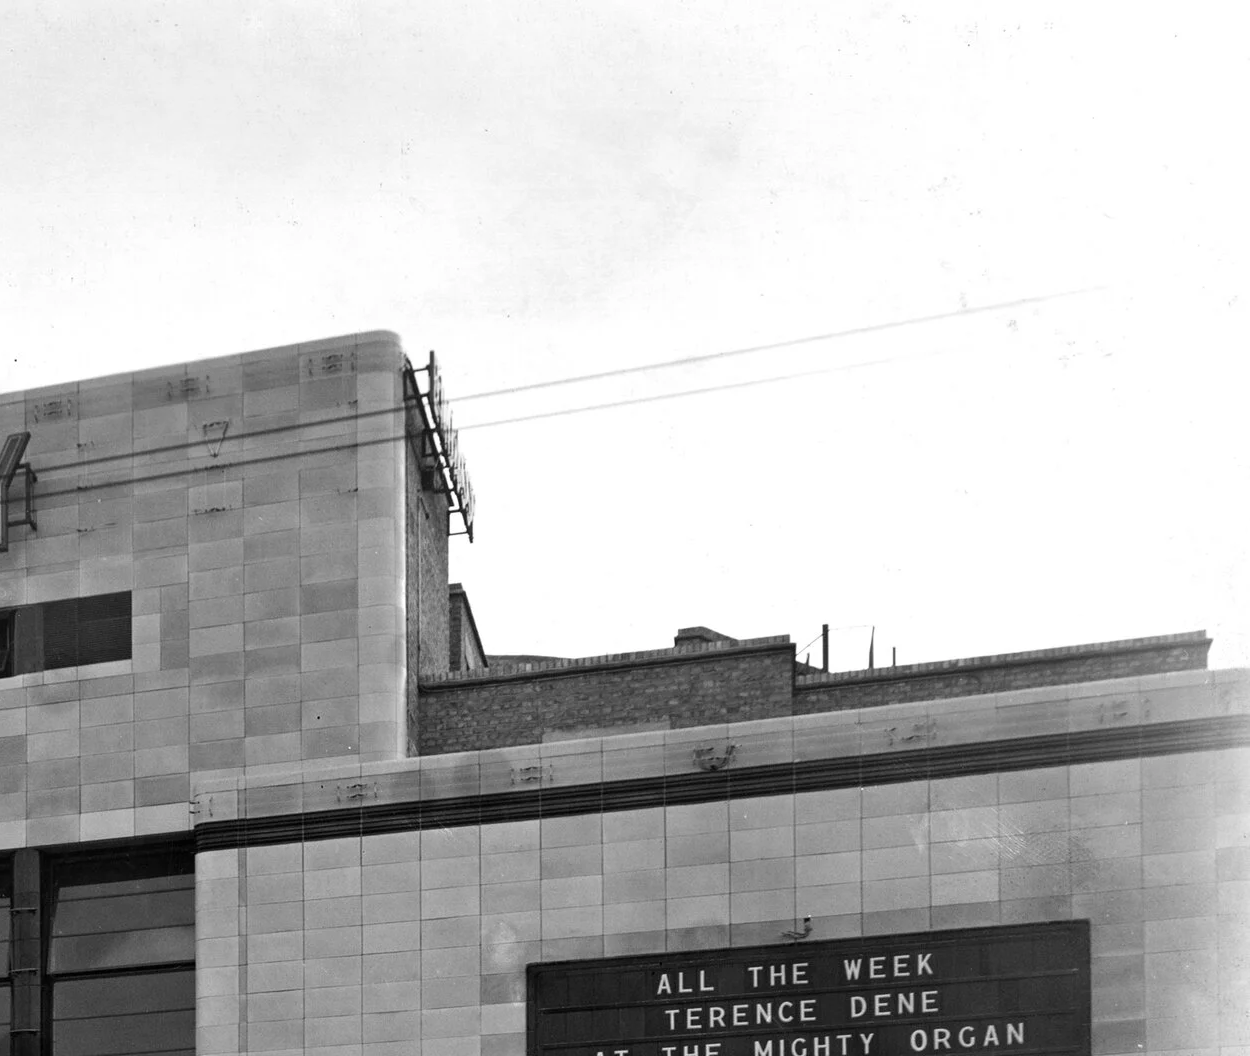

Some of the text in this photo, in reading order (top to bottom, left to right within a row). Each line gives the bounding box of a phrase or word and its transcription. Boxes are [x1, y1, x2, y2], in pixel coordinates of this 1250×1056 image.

[657, 953, 934, 995] ALL THE WEEK
[665, 990, 940, 1030] TERENCE DENE
[910, 1023, 1026, 1052] ORGAN
